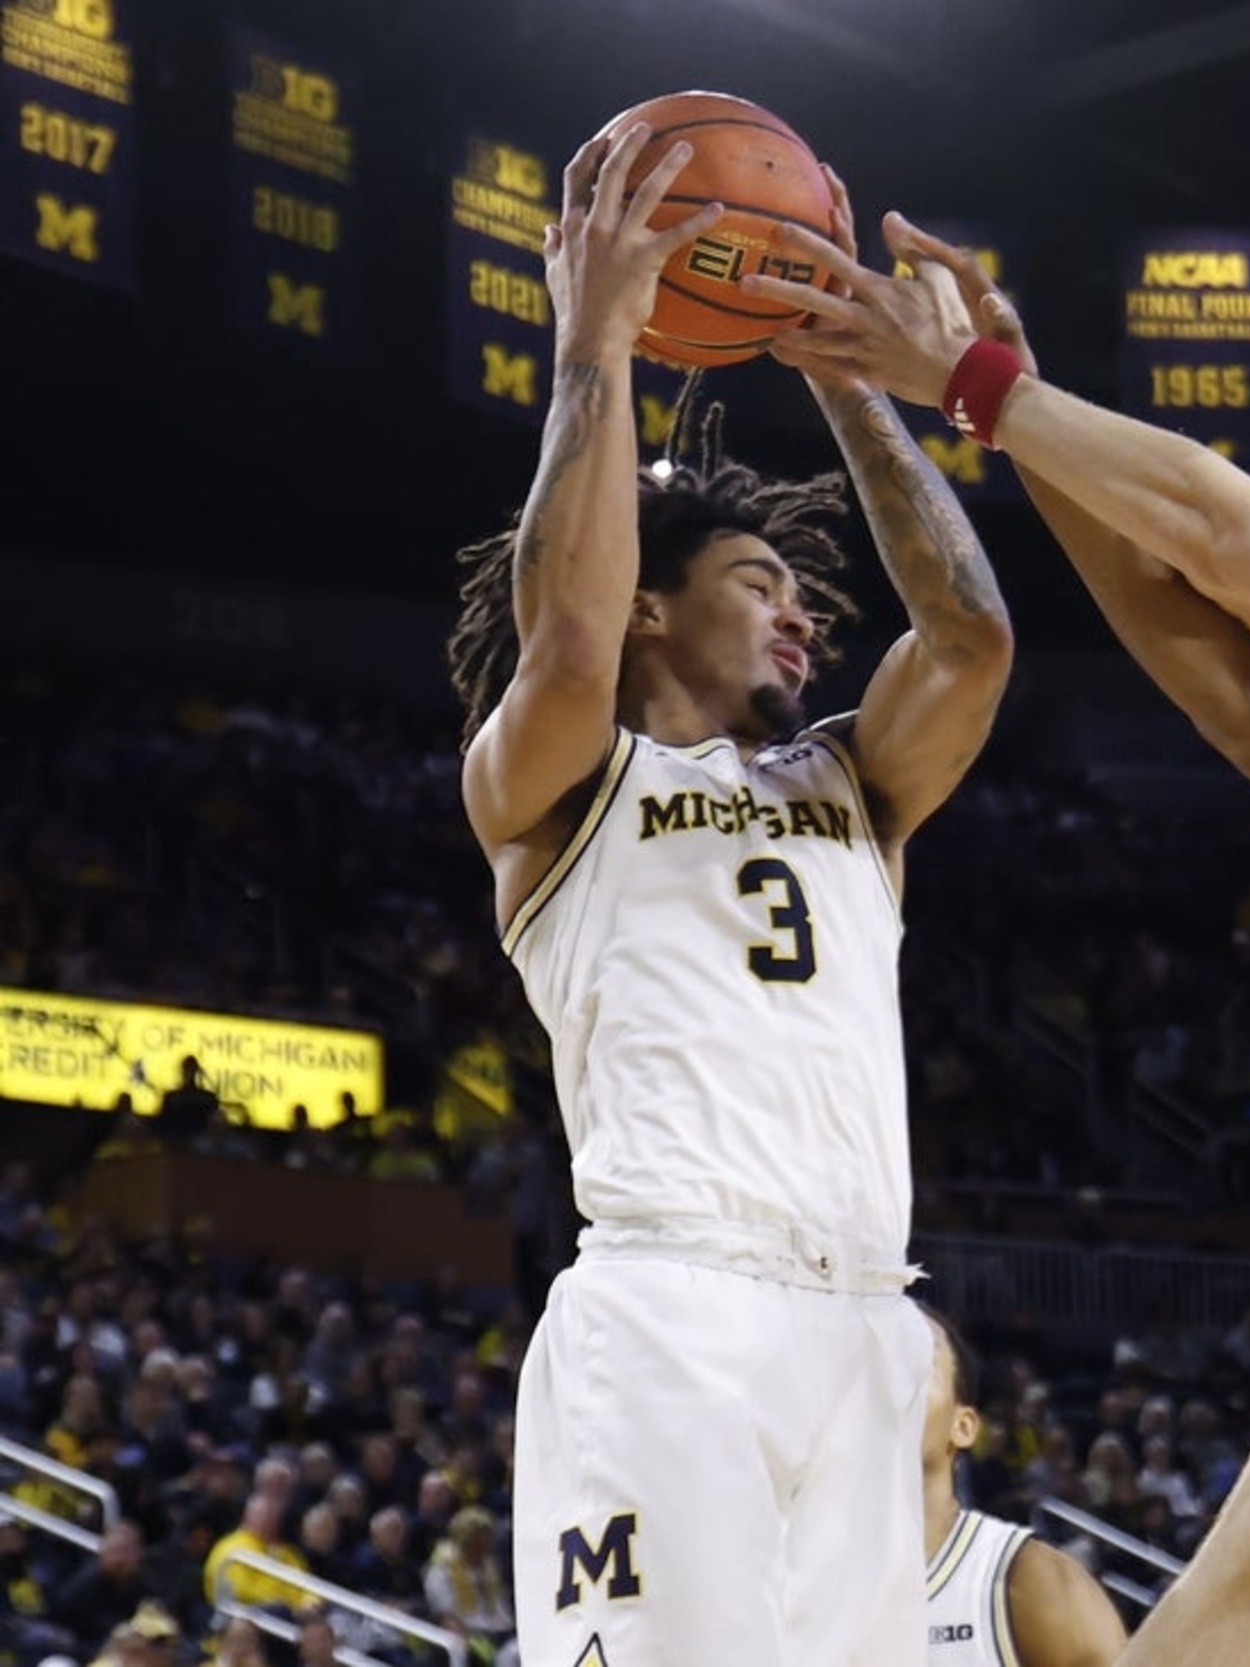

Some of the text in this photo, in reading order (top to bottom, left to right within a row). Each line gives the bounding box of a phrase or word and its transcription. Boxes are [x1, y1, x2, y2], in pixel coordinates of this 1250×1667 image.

[20, 104, 116, 175] 2017
[36, 195, 97, 262] M
[470, 259, 549, 328] 2021
[1142, 252, 1249, 289] NCAA
[267, 272, 327, 337] M
[1126, 289, 1196, 320] FINAL
[482, 344, 537, 406] M
[637, 787, 853, 852] MICHGAN
[735, 856, 820, 985] 3
[0, 1041, 284, 1101] REDIT NION
[143, 1023, 187, 1051] OF
[198, 1031, 367, 1073] MICHIGAN
[555, 1511, 642, 1614] M
